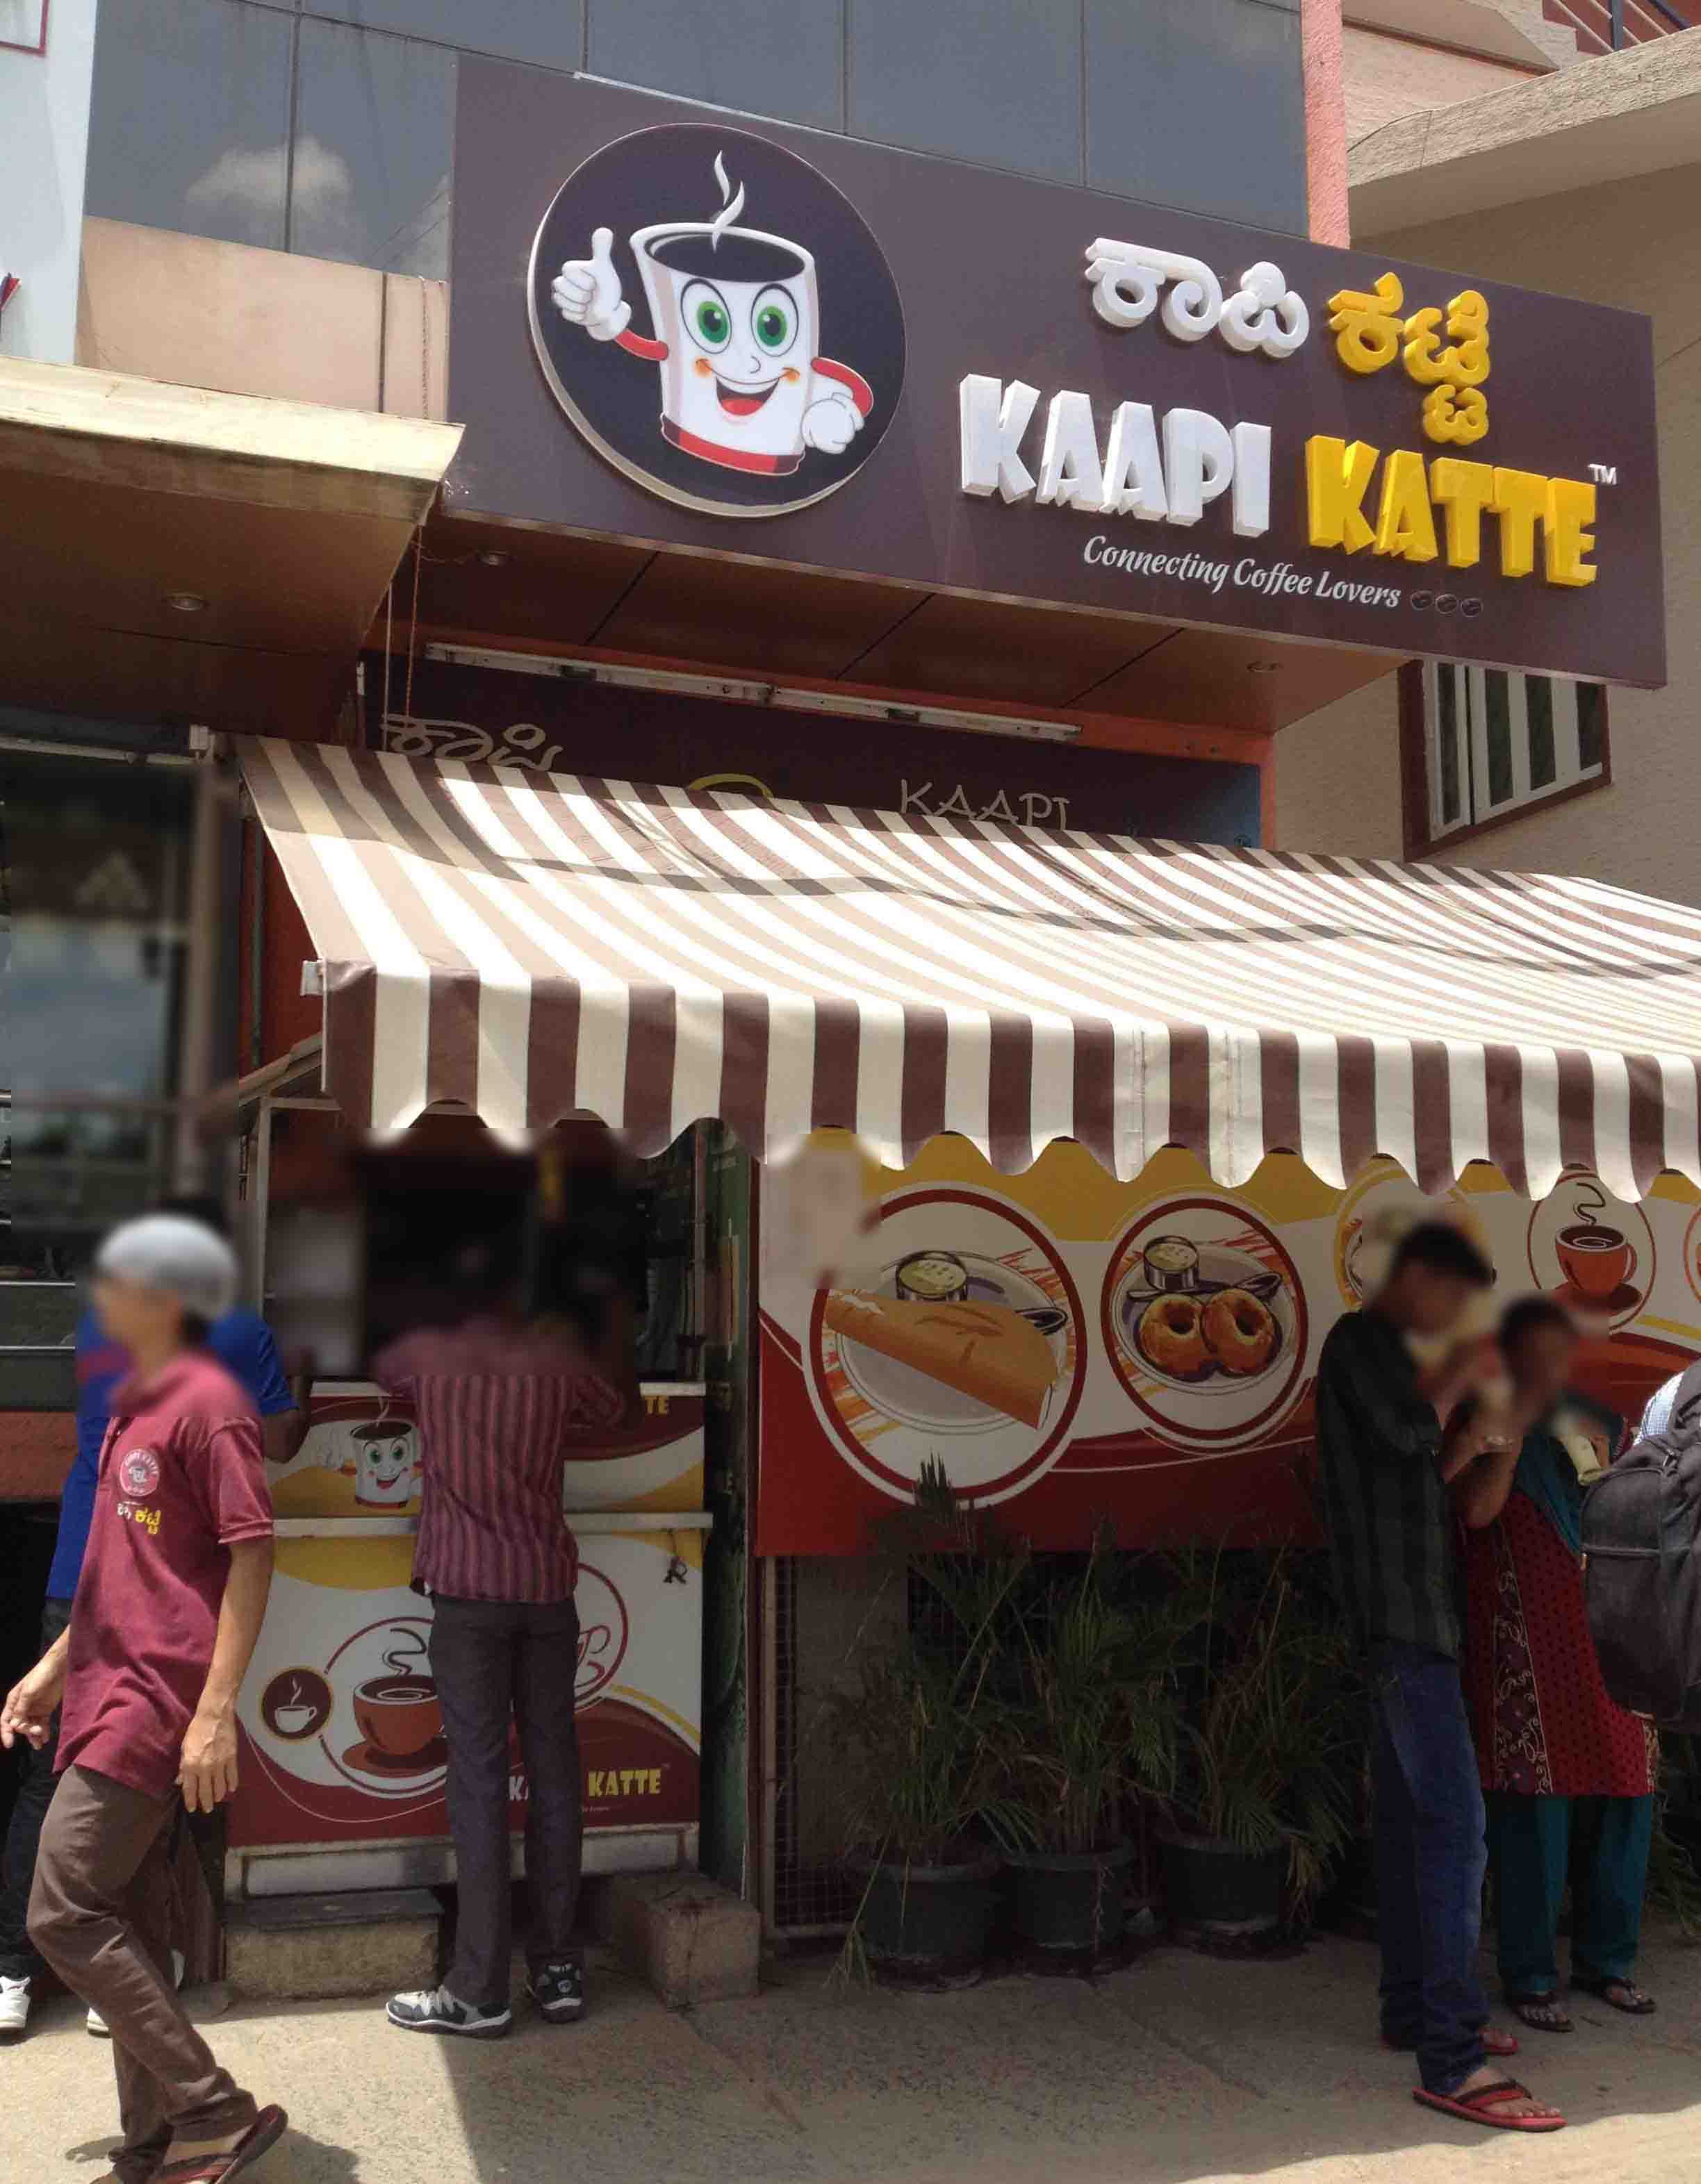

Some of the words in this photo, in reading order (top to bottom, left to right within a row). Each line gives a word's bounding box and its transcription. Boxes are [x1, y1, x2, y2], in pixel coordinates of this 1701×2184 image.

[960, 374, 1272, 537] KAAPI
[1304, 434, 1597, 588] KATTE
[1587, 463, 1618, 487] TM
[1083, 535, 1230, 595] Connecting
[1233, 558, 1313, 595] Coffee
[1317, 572, 1402, 607] Lovers
[901, 779, 1070, 831] KAAPI
[589, 1769, 662, 1797] KATTE
